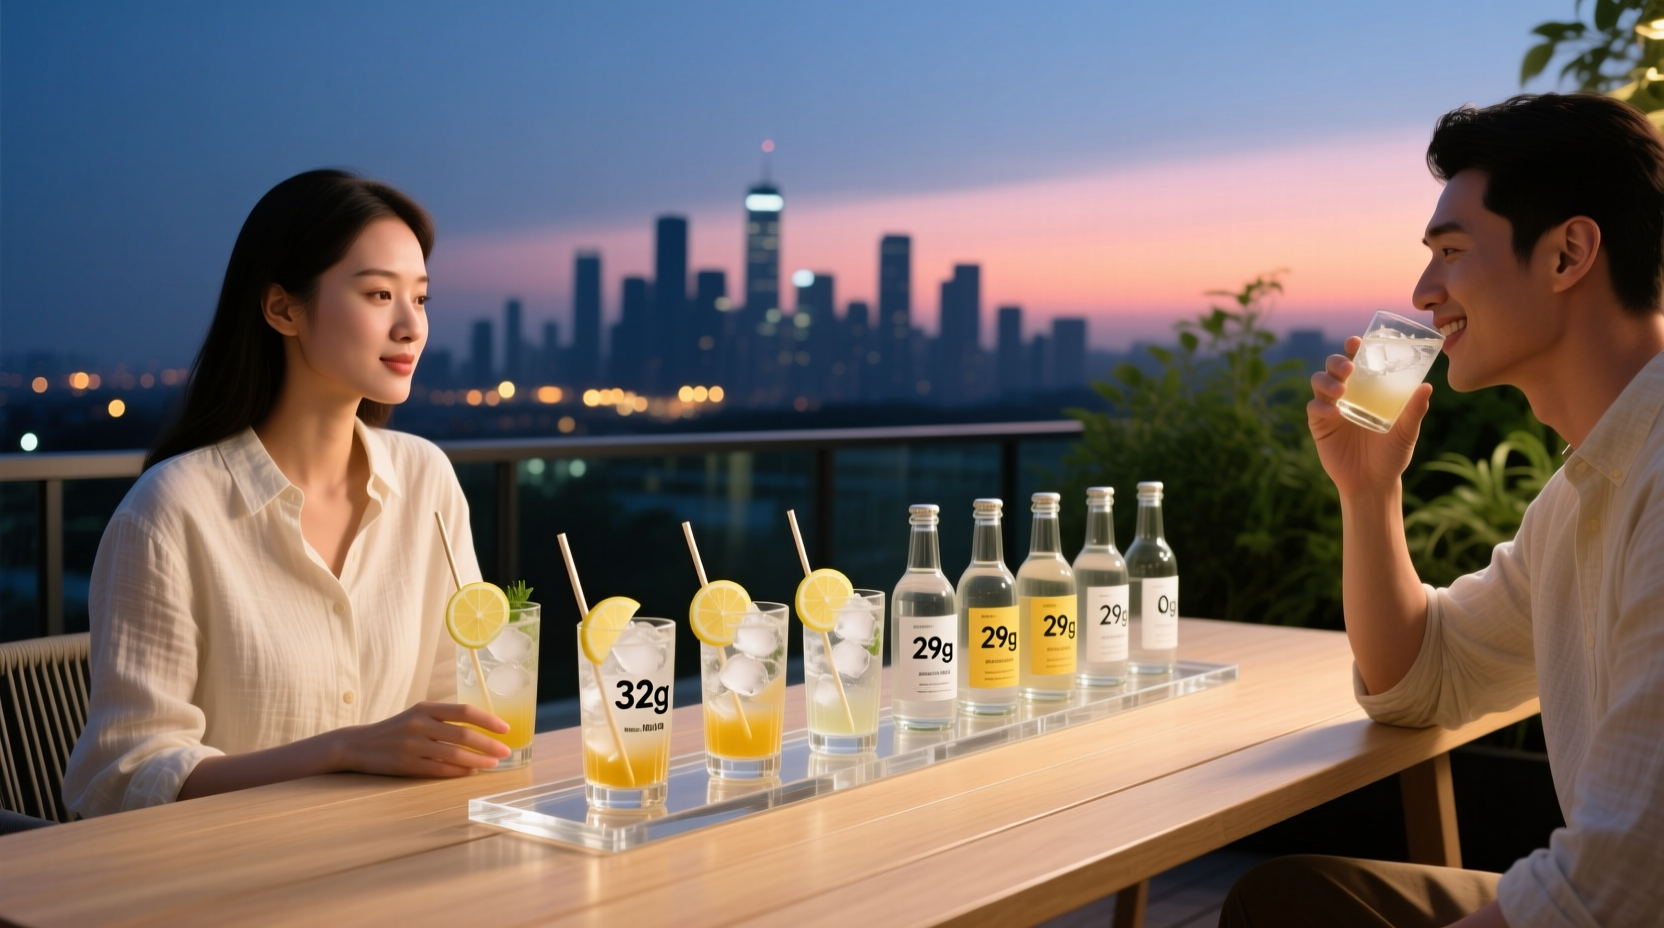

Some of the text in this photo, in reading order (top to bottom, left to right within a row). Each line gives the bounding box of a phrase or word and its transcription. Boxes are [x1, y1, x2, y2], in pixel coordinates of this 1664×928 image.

[1099, 604, 1127, 627] 29g
[1158, 595, 1176, 617] 0g
[981, 625, 1017, 651] 29g
[1043, 614, 1076, 639] 29g
[912, 636, 953, 663] 29g
[615, 678, 669, 715] 32g
